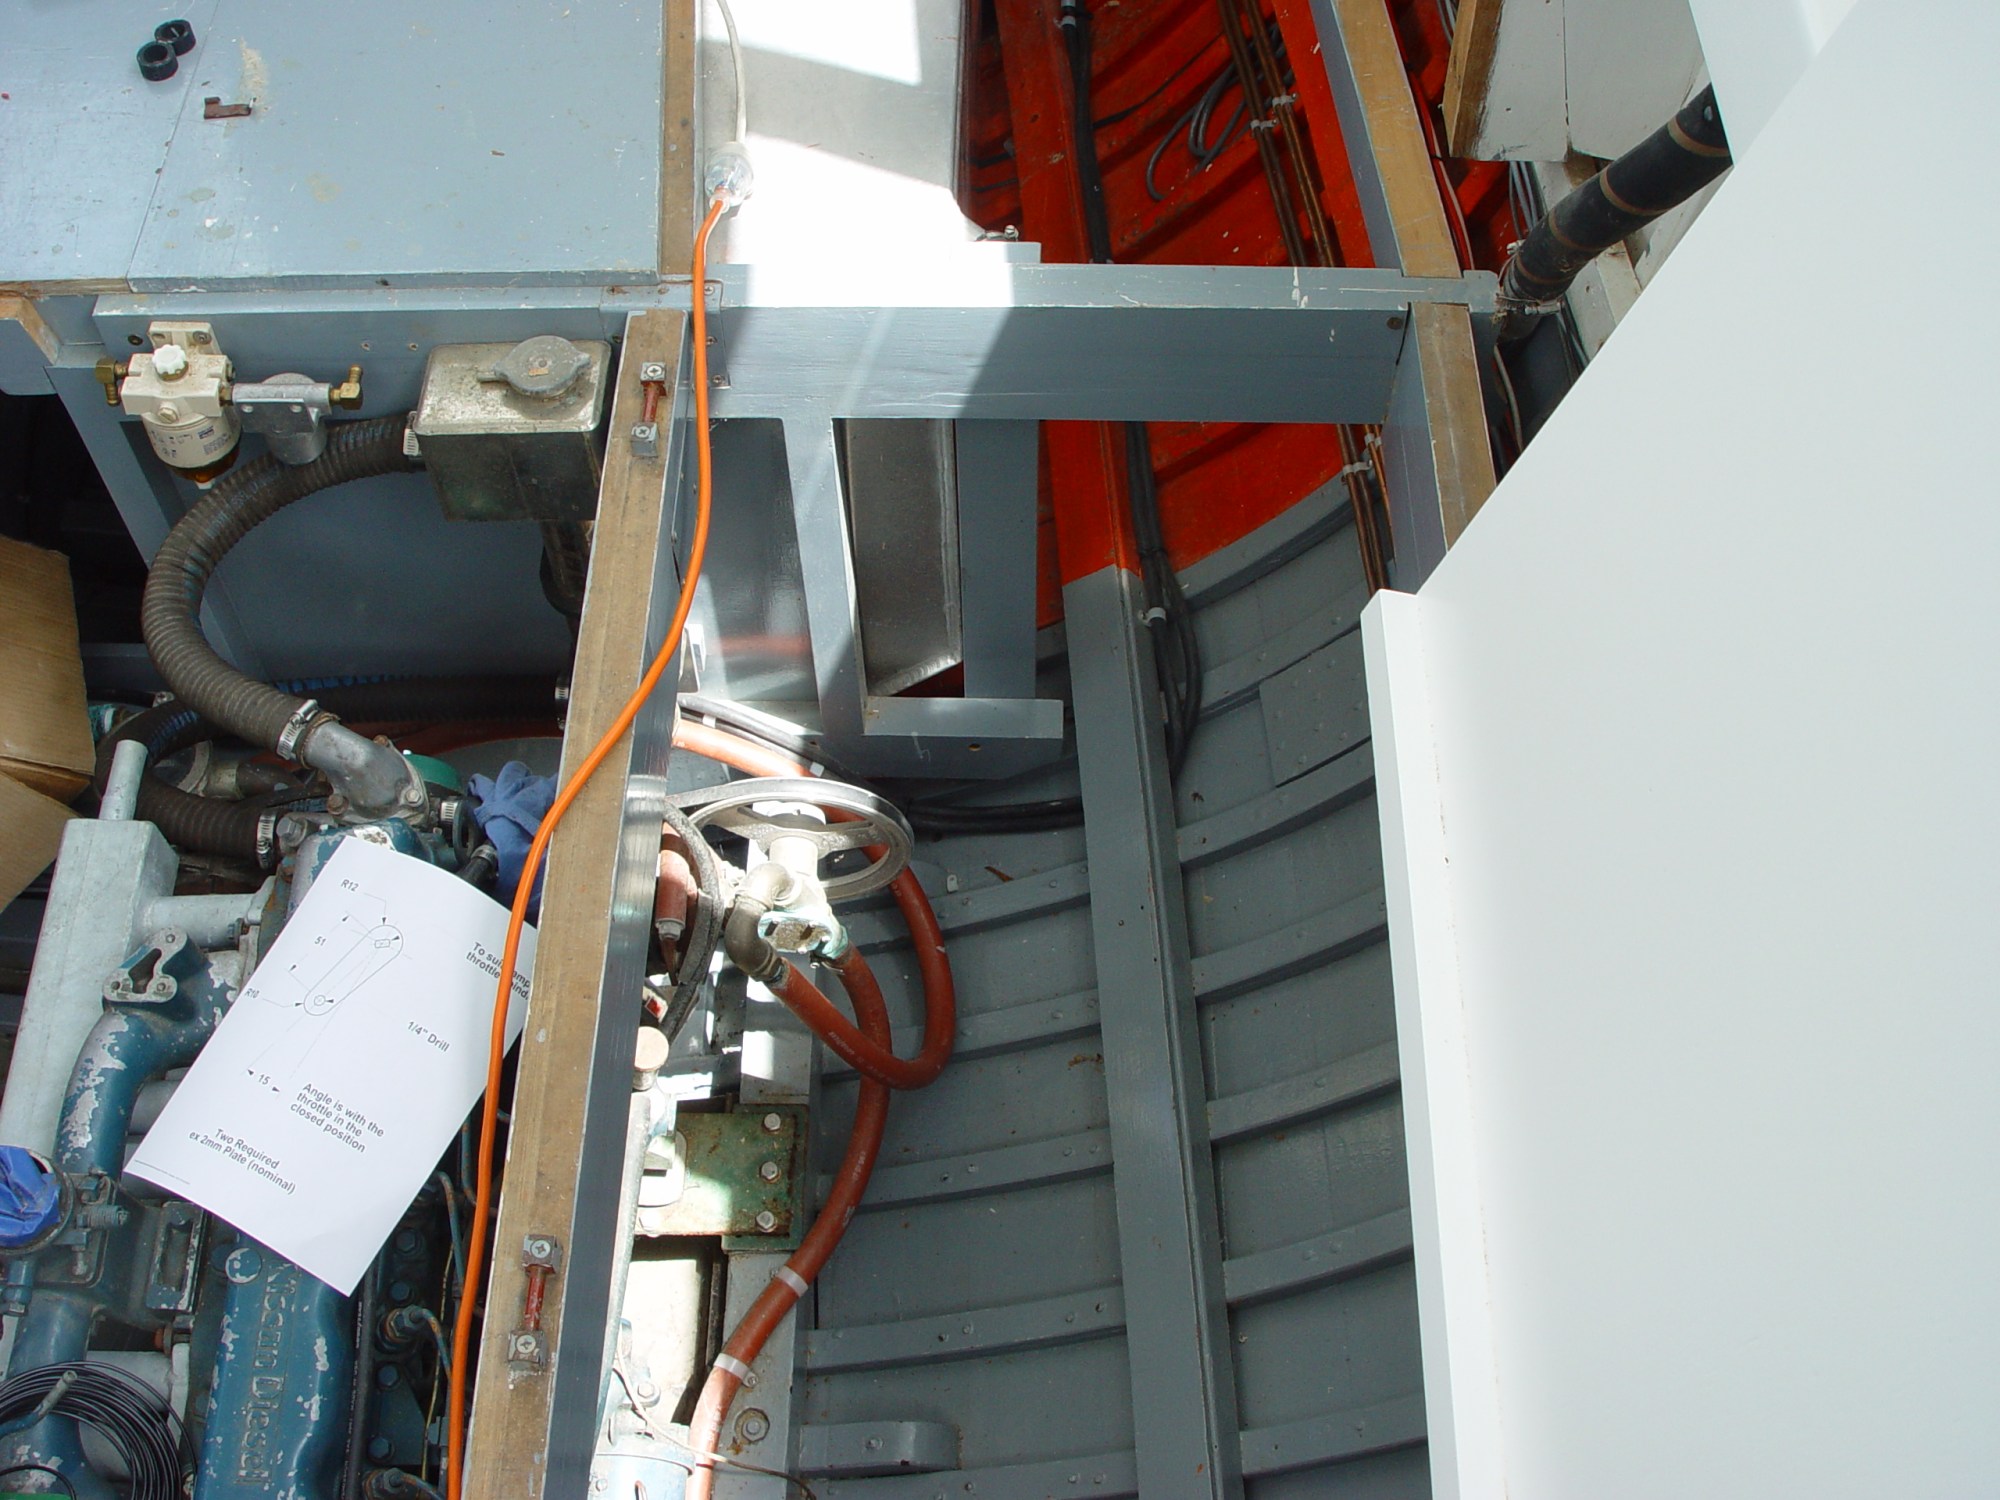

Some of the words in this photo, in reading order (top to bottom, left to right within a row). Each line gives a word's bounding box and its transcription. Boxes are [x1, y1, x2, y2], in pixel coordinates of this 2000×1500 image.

[340, 879, 360, 892] R12
[314, 936, 327, 947] 51
[473, 941, 486, 956] To
[486, 953, 504, 970] sui
[466, 951, 501, 979] throttle
[407, 1021, 428, 1035] 1/4"
[427, 1033, 450, 1052] Drill
[257, 1074, 271, 1086] 15
[290, 1103, 326, 1127] closed
[322, 1123, 366, 1153] position
[296, 1092, 333, 1119] throttle
[333, 1113, 345, 1126] in
[345, 1121, 363, 1137] the
[302, 1083, 333, 1105] Angle
[333, 1099, 344, 1112] is
[344, 1108, 367, 1126] with
[366, 1121, 385, 1137] the
[188, 1131, 200, 1141] ex
[199, 1134, 223, 1152] 2mm
[222, 1145, 247, 1165] Plate
[246, 1159, 297, 1196] (nominal)
[215, 1128, 234, 1144] Two
[234, 1138, 281, 1169] Required
[253, 1259, 298, 1370] Nissan
[235, 1375, 285, 1483] Diesel
